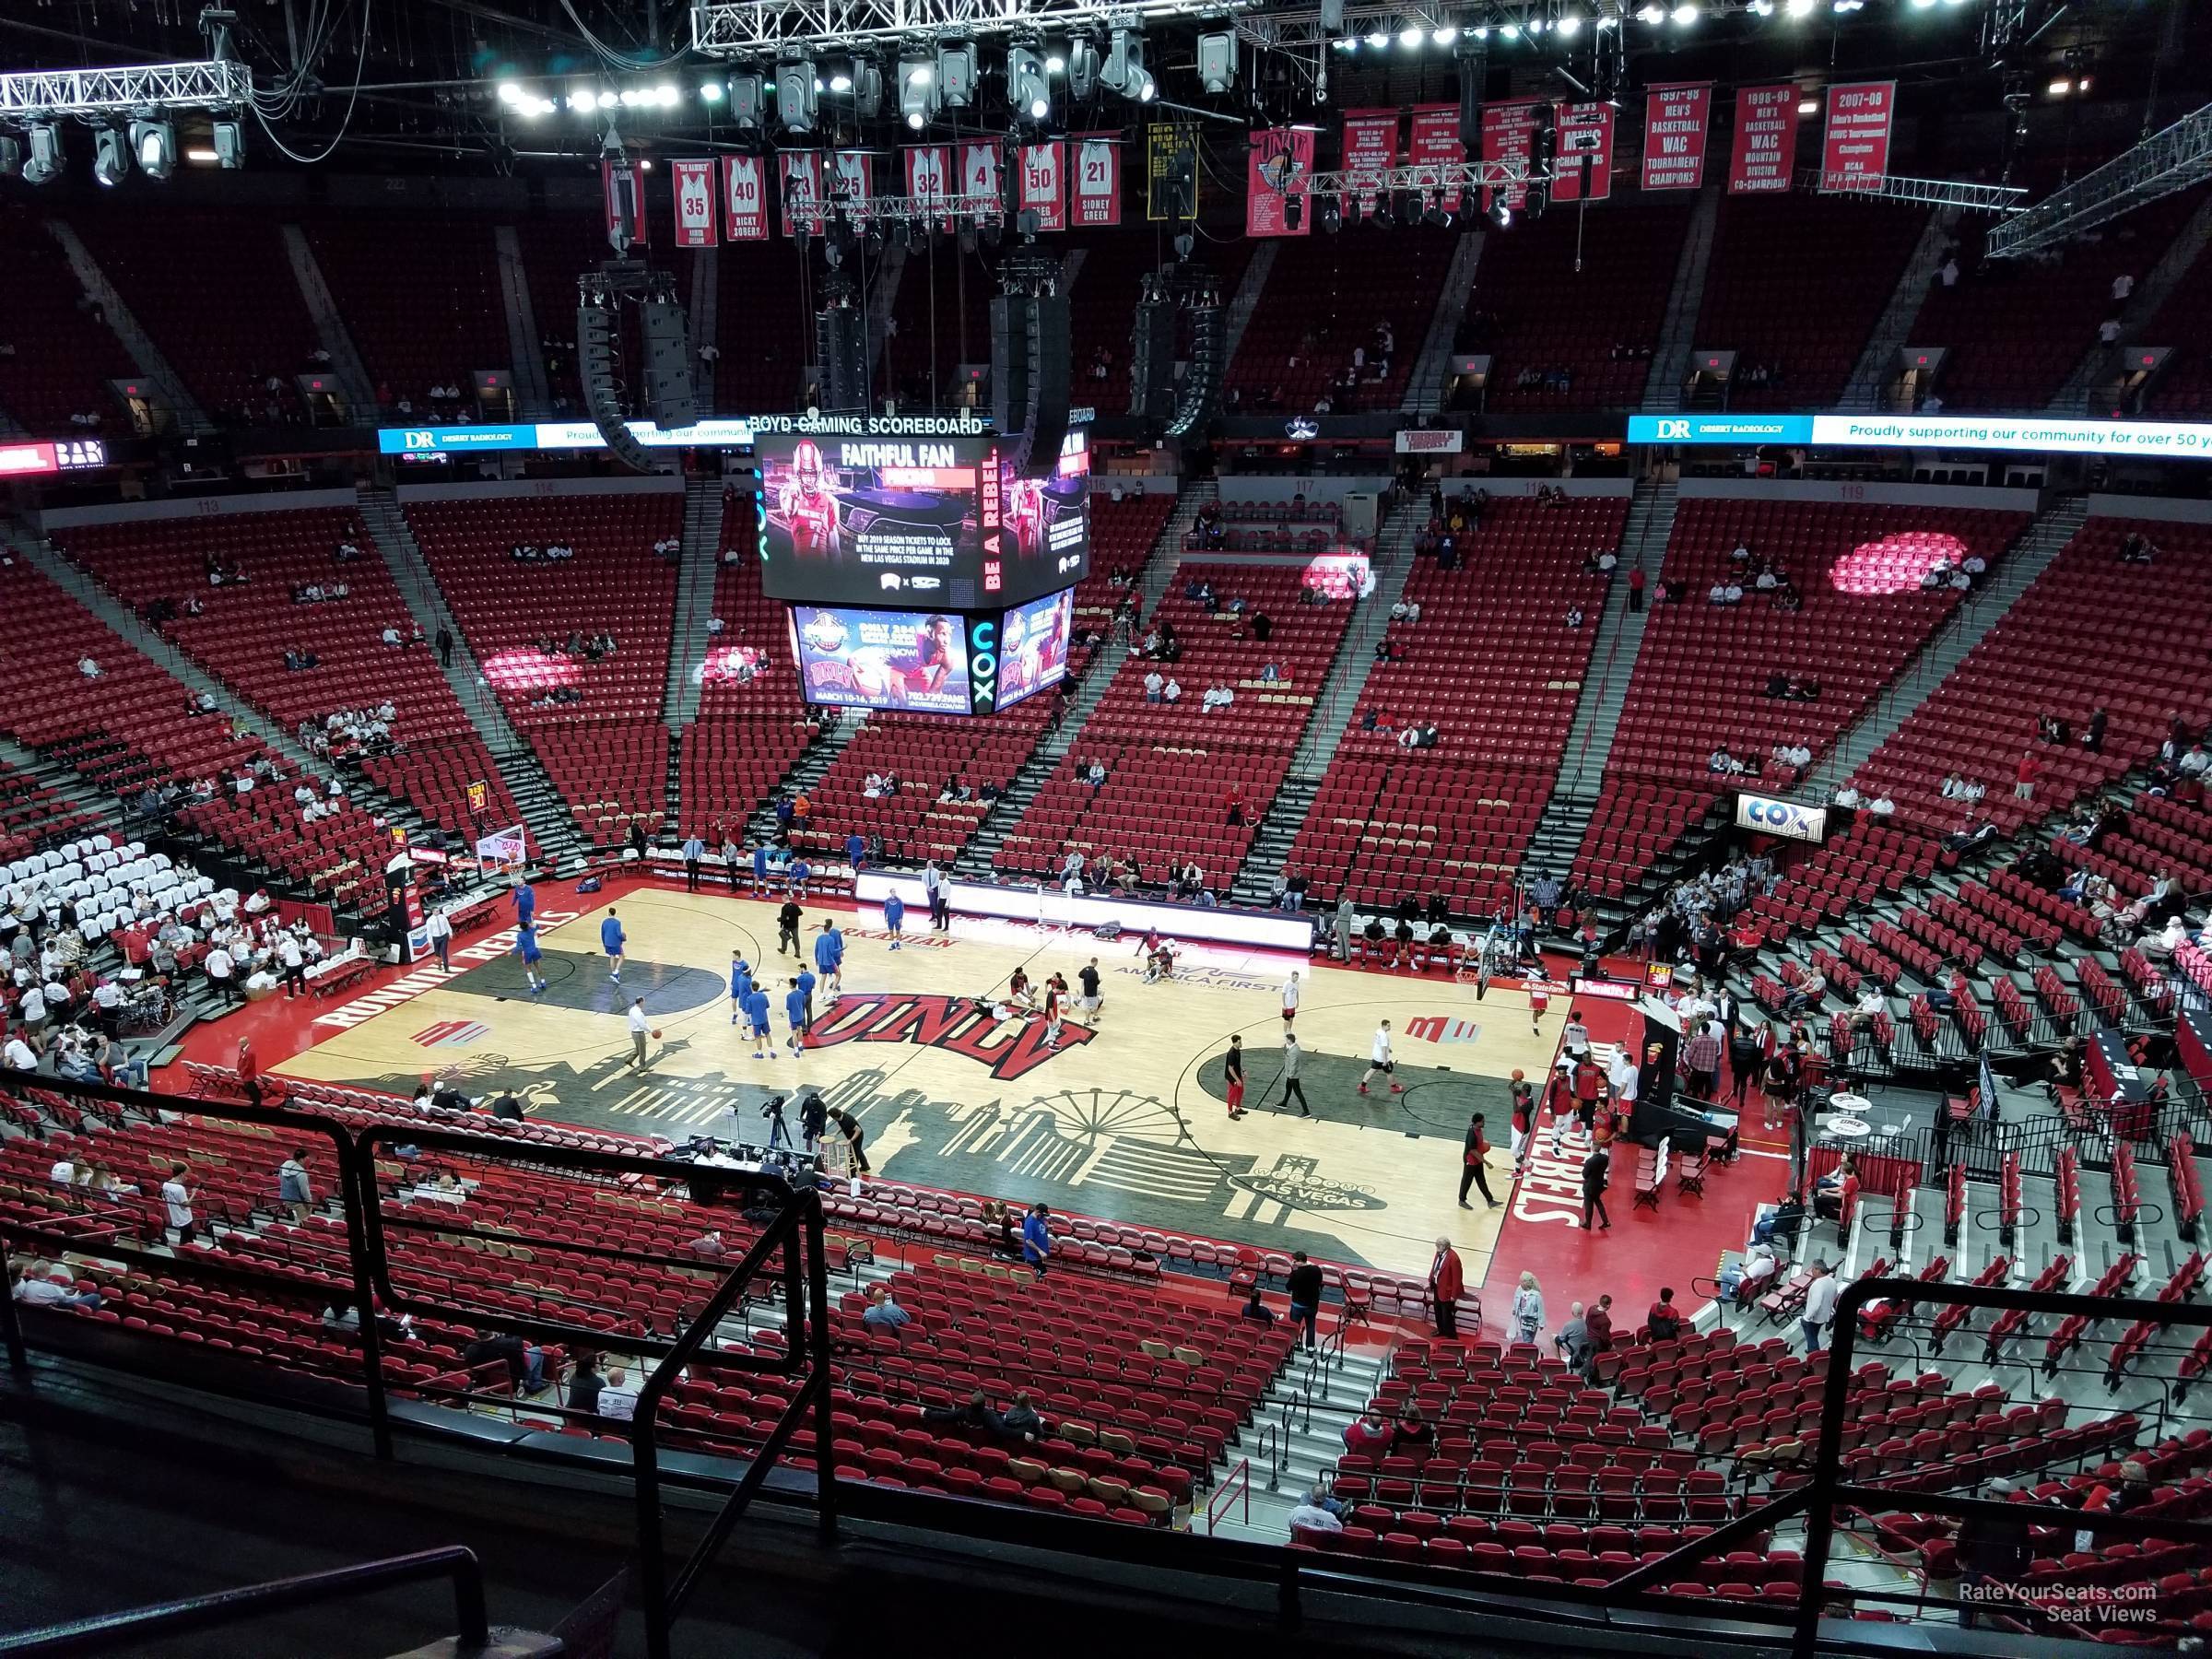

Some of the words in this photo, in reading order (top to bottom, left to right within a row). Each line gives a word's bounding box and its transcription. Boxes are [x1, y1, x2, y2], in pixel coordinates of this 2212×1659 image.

[1748, 90, 1790, 105] 1998-99
[1839, 92, 1882, 108] 2007-08
[1665, 105, 1689, 117] MEN'S
[1757, 107, 1777, 117] MEN'S
[1652, 120, 1700, 134] BASKETBALL
[1746, 121, 1786, 132] BASKETBALL
[1663, 136, 1688, 153] WAC
[1751, 135, 1778, 149] WAC
[1559, 155, 1604, 167] CHAMNS
[1648, 156, 1700, 171] TOURNAMENT
[1746, 152, 1781, 163] MOUNTAIN
[1088, 161, 1105, 182] 21
[1747, 165, 1776, 176] DIVISION
[1844, 162, 1864, 171] NCAA
[918, 173, 938, 194] 32
[975, 167, 987, 185] 4
[1030, 169, 1051, 189] 50
[1650, 172, 1693, 184] CHAMPIONS
[1735, 177, 1785, 190] CO-CHAMPIONS
[735, 182, 755, 200] 40
[842, 177, 860, 195] 25
[686, 197, 704, 215] 35
[1082, 199, 1110, 210] SIDNEY
[735, 217, 756, 227] RICKY
[1084, 210, 1109, 221] GREEN
[1069, 407, 1095, 424] EBOARD
[750, 415, 791, 432] BOYD
[798, 417, 863, 433] GAMING
[869, 418, 982, 434] SCOREBOARD
[1656, 419, 1691, 439] DR
[405, 430, 436, 449] DR
[567, 430, 598, 440] Proud
[1850, 425, 1903, 438] Proudly
[1909, 427, 1987, 440] supporting
[1993, 429, 2017, 440] our
[2022, 429, 2104, 444] community
[2111, 430, 2132, 443] for
[2137, 435, 2171, 445] over
[2177, 434, 2196, 445] 50
[841, 443, 916, 466] FAITHFUL
[919, 444, 955, 467] FAN
[982, 448, 999, 527] REBEL.
[1297, 480, 1314, 492] 117
[1841, 486, 1864, 500] 119
[870, 535, 882, 544] 2019
[883, 535, 904, 544] SEASON
[905, 536, 926, 545] TICKETS
[928, 536, 935, 545] TO
[936, 536, 951, 546] LOCK
[984, 535, 1000, 553] A
[863, 545, 874, 553] THE
[875, 545, 888, 553] SAME
[890, 546, 905, 554] PRICE
[906, 546, 916, 554] PER
[917, 547, 933, 555] GAME
[935, 547, 942, 555] IN
[943, 547, 954, 556] THE
[875, 555, 884, 563] LAS
[885, 555, 902, 563] VEGAS
[903, 556, 928, 564] STADIUM
[929, 556, 935, 564] IN
[935, 557, 949, 565] 2020
[985, 561, 1001, 590] BE
[972, 622, 996, 702] COX
[810, 661, 853, 688] UNLV
[816, 692, 843, 702] MARCH
[869, 696, 888, 705] 2019
[472, 794, 485, 808] 30
[1748, 800, 1808, 831] COX
[1113, 967, 1211, 984] AMRICA
[1216, 979, 1283, 993] FIRST
[311, 961, 469, 1028] RUNNIN
[787, 993, 1100, 1081] UNLV
[1254, 1168, 1375, 1194] WELCOME
[1252, 1181, 1292, 1195] LAS
[1298, 1188, 1367, 1207] VEGAS
[1277, 1194, 1328, 1207] NEVADA
